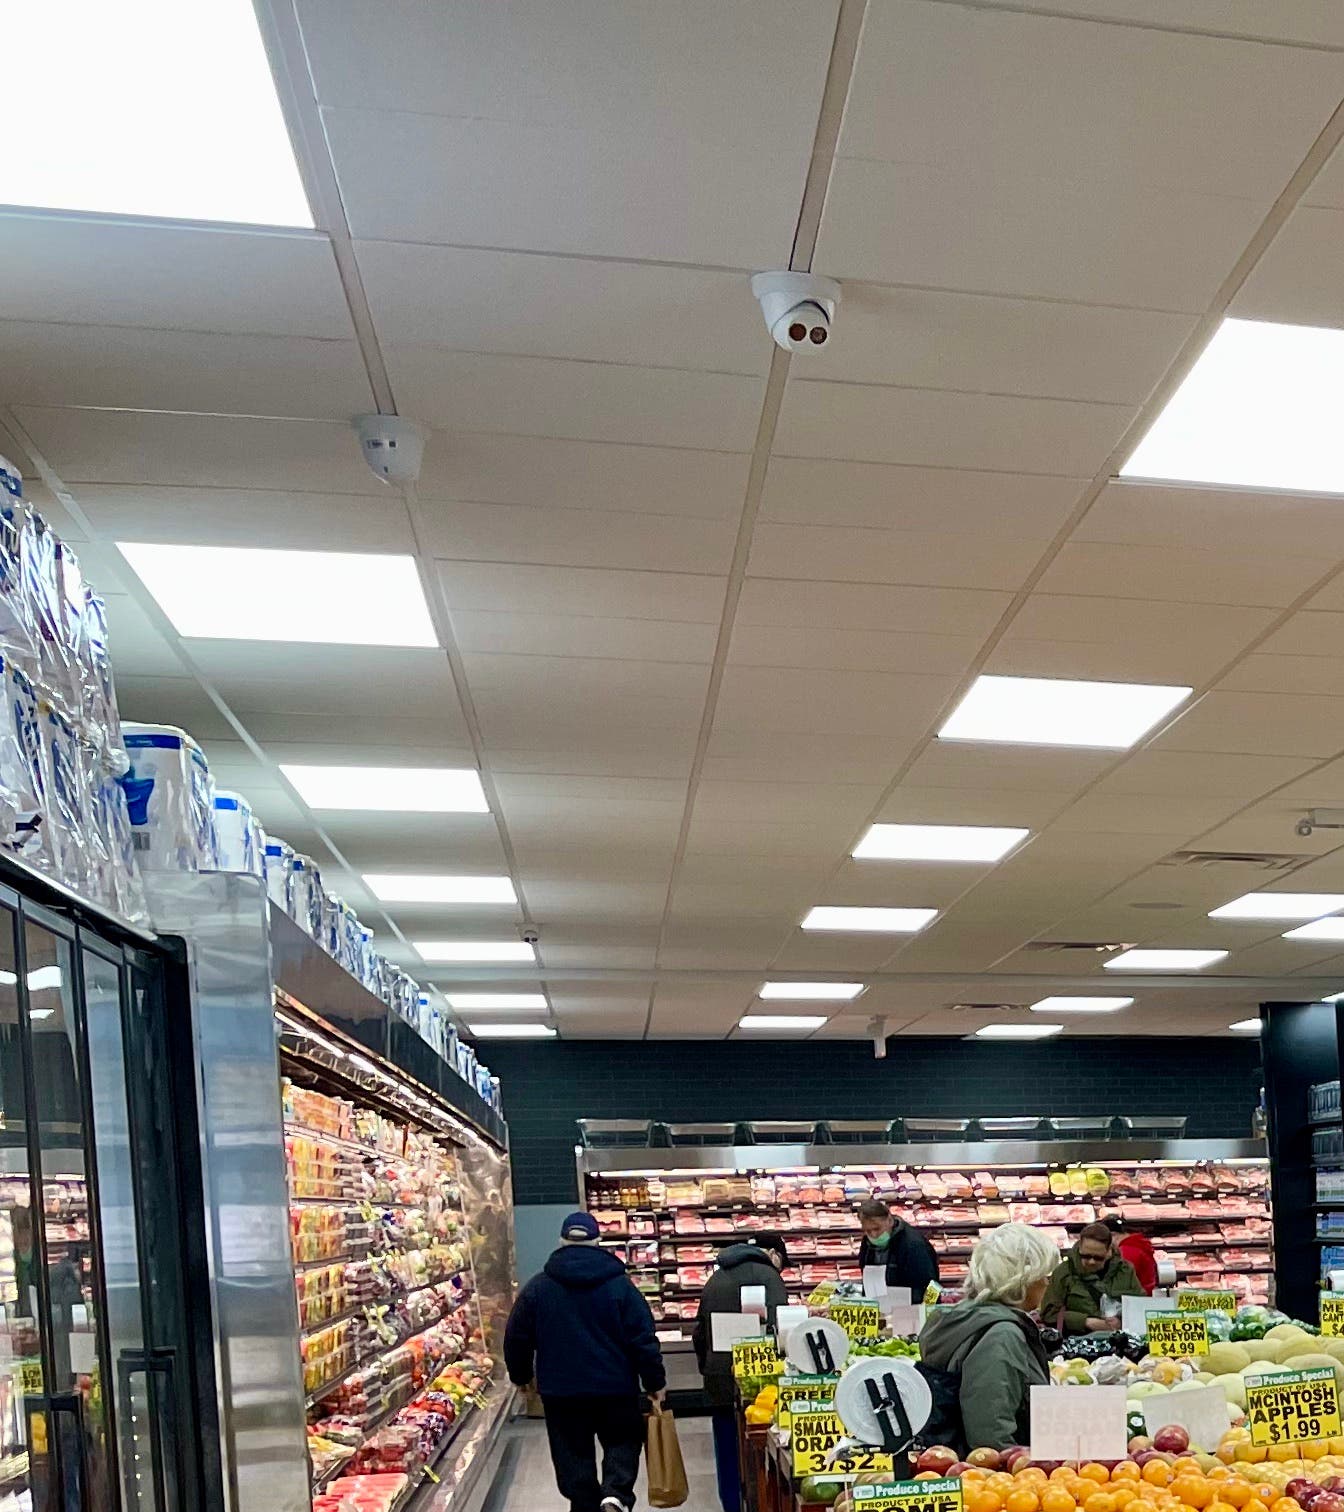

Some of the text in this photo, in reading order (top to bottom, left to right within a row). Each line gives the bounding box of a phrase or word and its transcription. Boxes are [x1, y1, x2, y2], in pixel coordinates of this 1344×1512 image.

[831, 1310, 877, 1320] ITALIAN
[1149, 1323, 1204, 1332] MELON
[1150, 1332, 1205, 1342] HONEYDEW
[1161, 1342, 1195, 1355] $4.99
[743, 1363, 773, 1375] $1.99
[1264, 1369, 1334, 1385] Produce Special
[1249, 1388, 1334, 1409] MCINTOSH
[1252, 1401, 1337, 1424] APPLES
[794, 1422, 840, 1436] SMALL
[1269, 1419, 1320, 1443] $1.99
[876, 1479, 960, 1496] Produce Special
[861, 1499, 910, 1509] PRODUCT
[931, 1495, 952, 1503] USA
